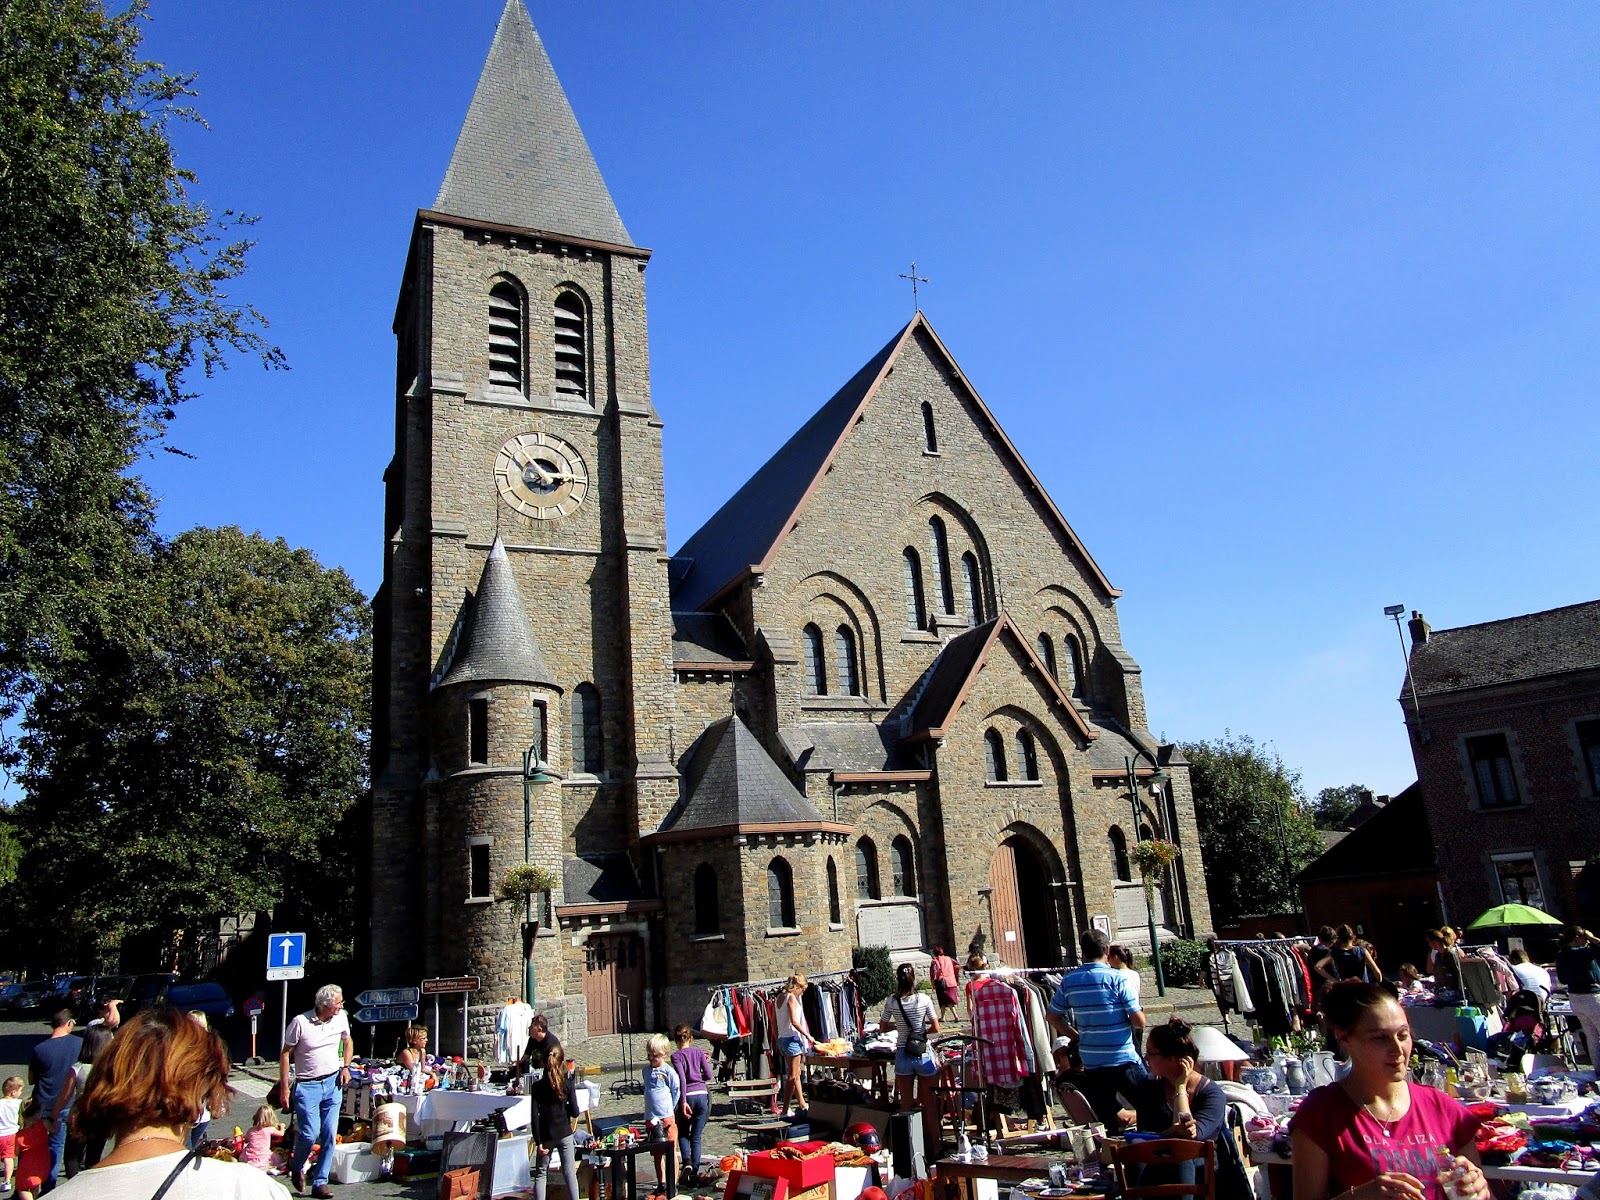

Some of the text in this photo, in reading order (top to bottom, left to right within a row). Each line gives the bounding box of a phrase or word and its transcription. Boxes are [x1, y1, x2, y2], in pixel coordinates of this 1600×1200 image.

[364, 1008, 409, 1020] 9 Lillois
[1362, 1134, 1391, 1147] OLA
[1406, 1132, 1437, 1146] LIZA
